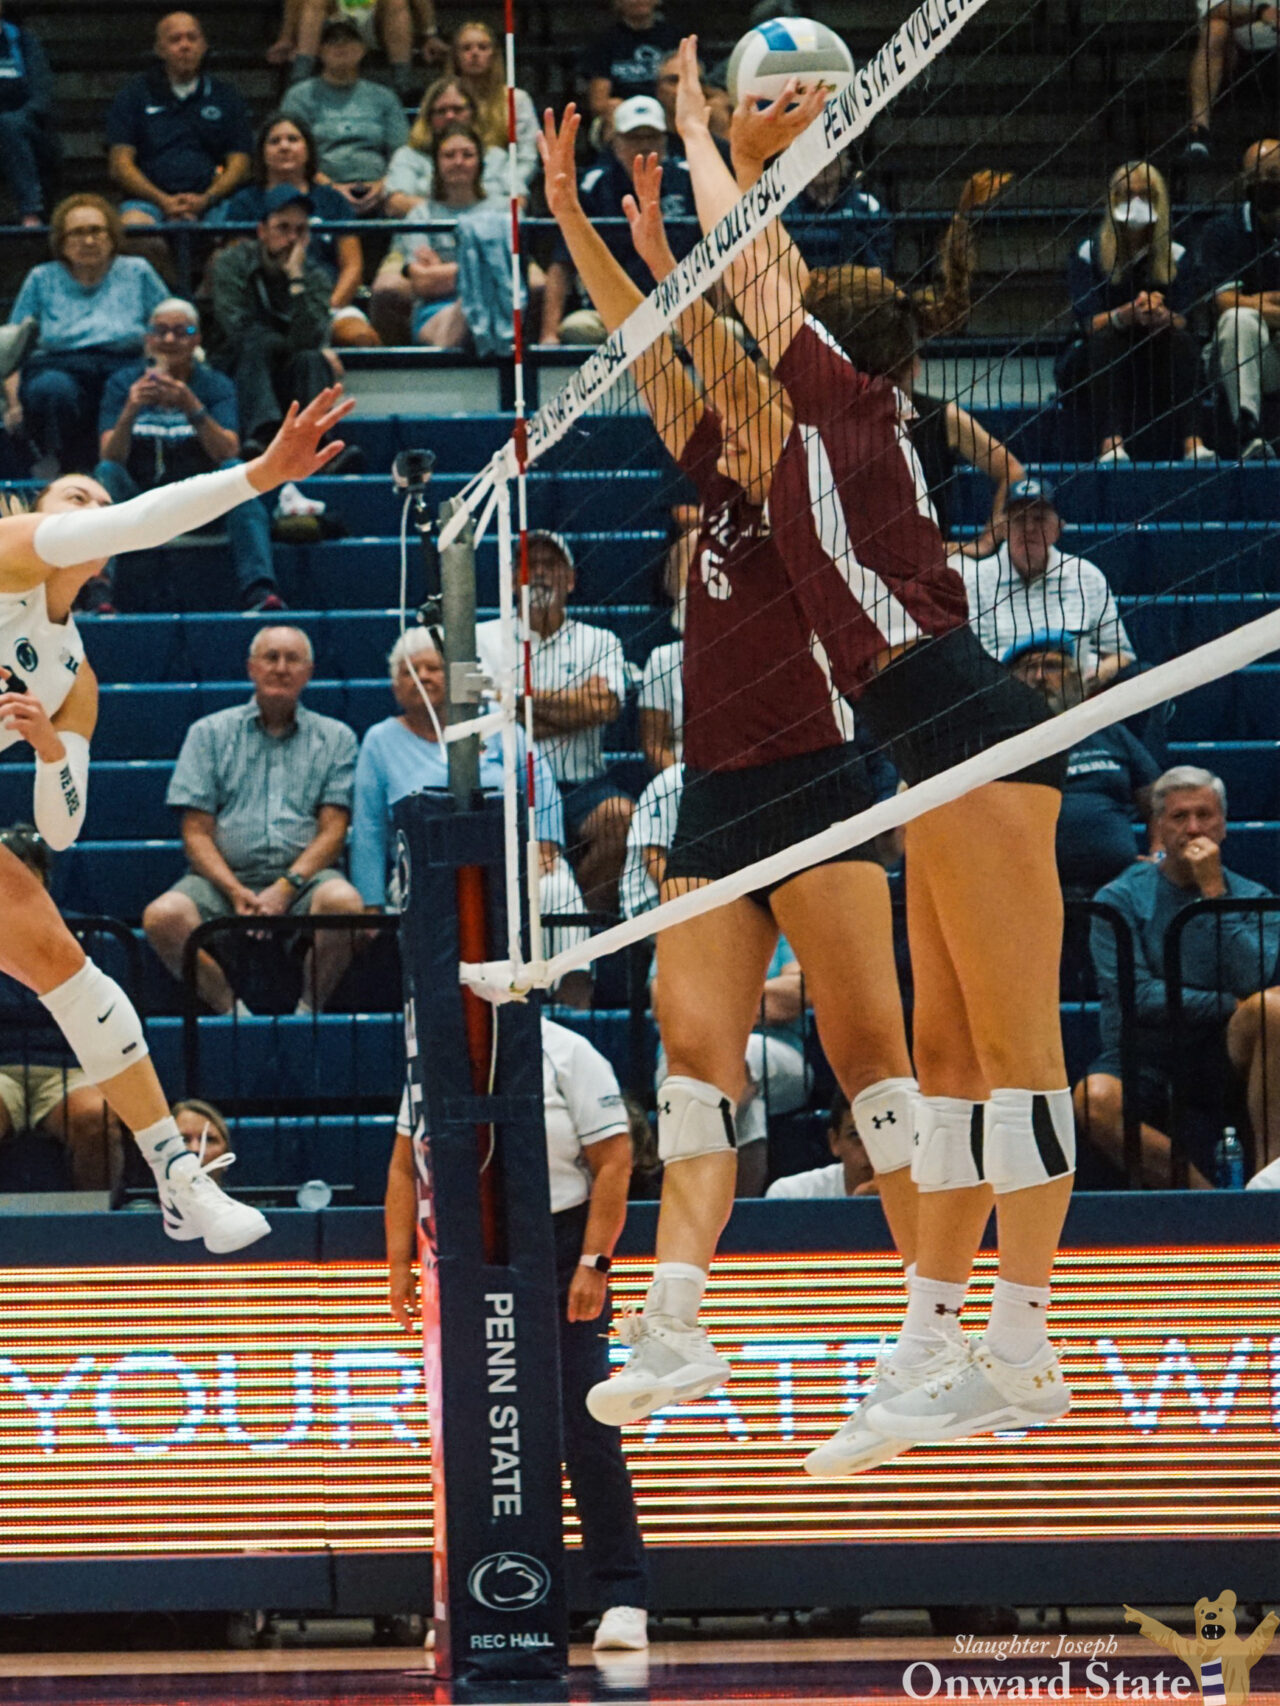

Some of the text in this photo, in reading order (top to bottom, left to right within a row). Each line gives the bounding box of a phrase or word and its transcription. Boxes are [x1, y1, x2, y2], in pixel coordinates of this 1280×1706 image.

[823, 0, 973, 149] PENN STATE VOLLE
[484, 1293, 522, 1517] PENN STATE
[470, 1632, 555, 1649] REC HALL
